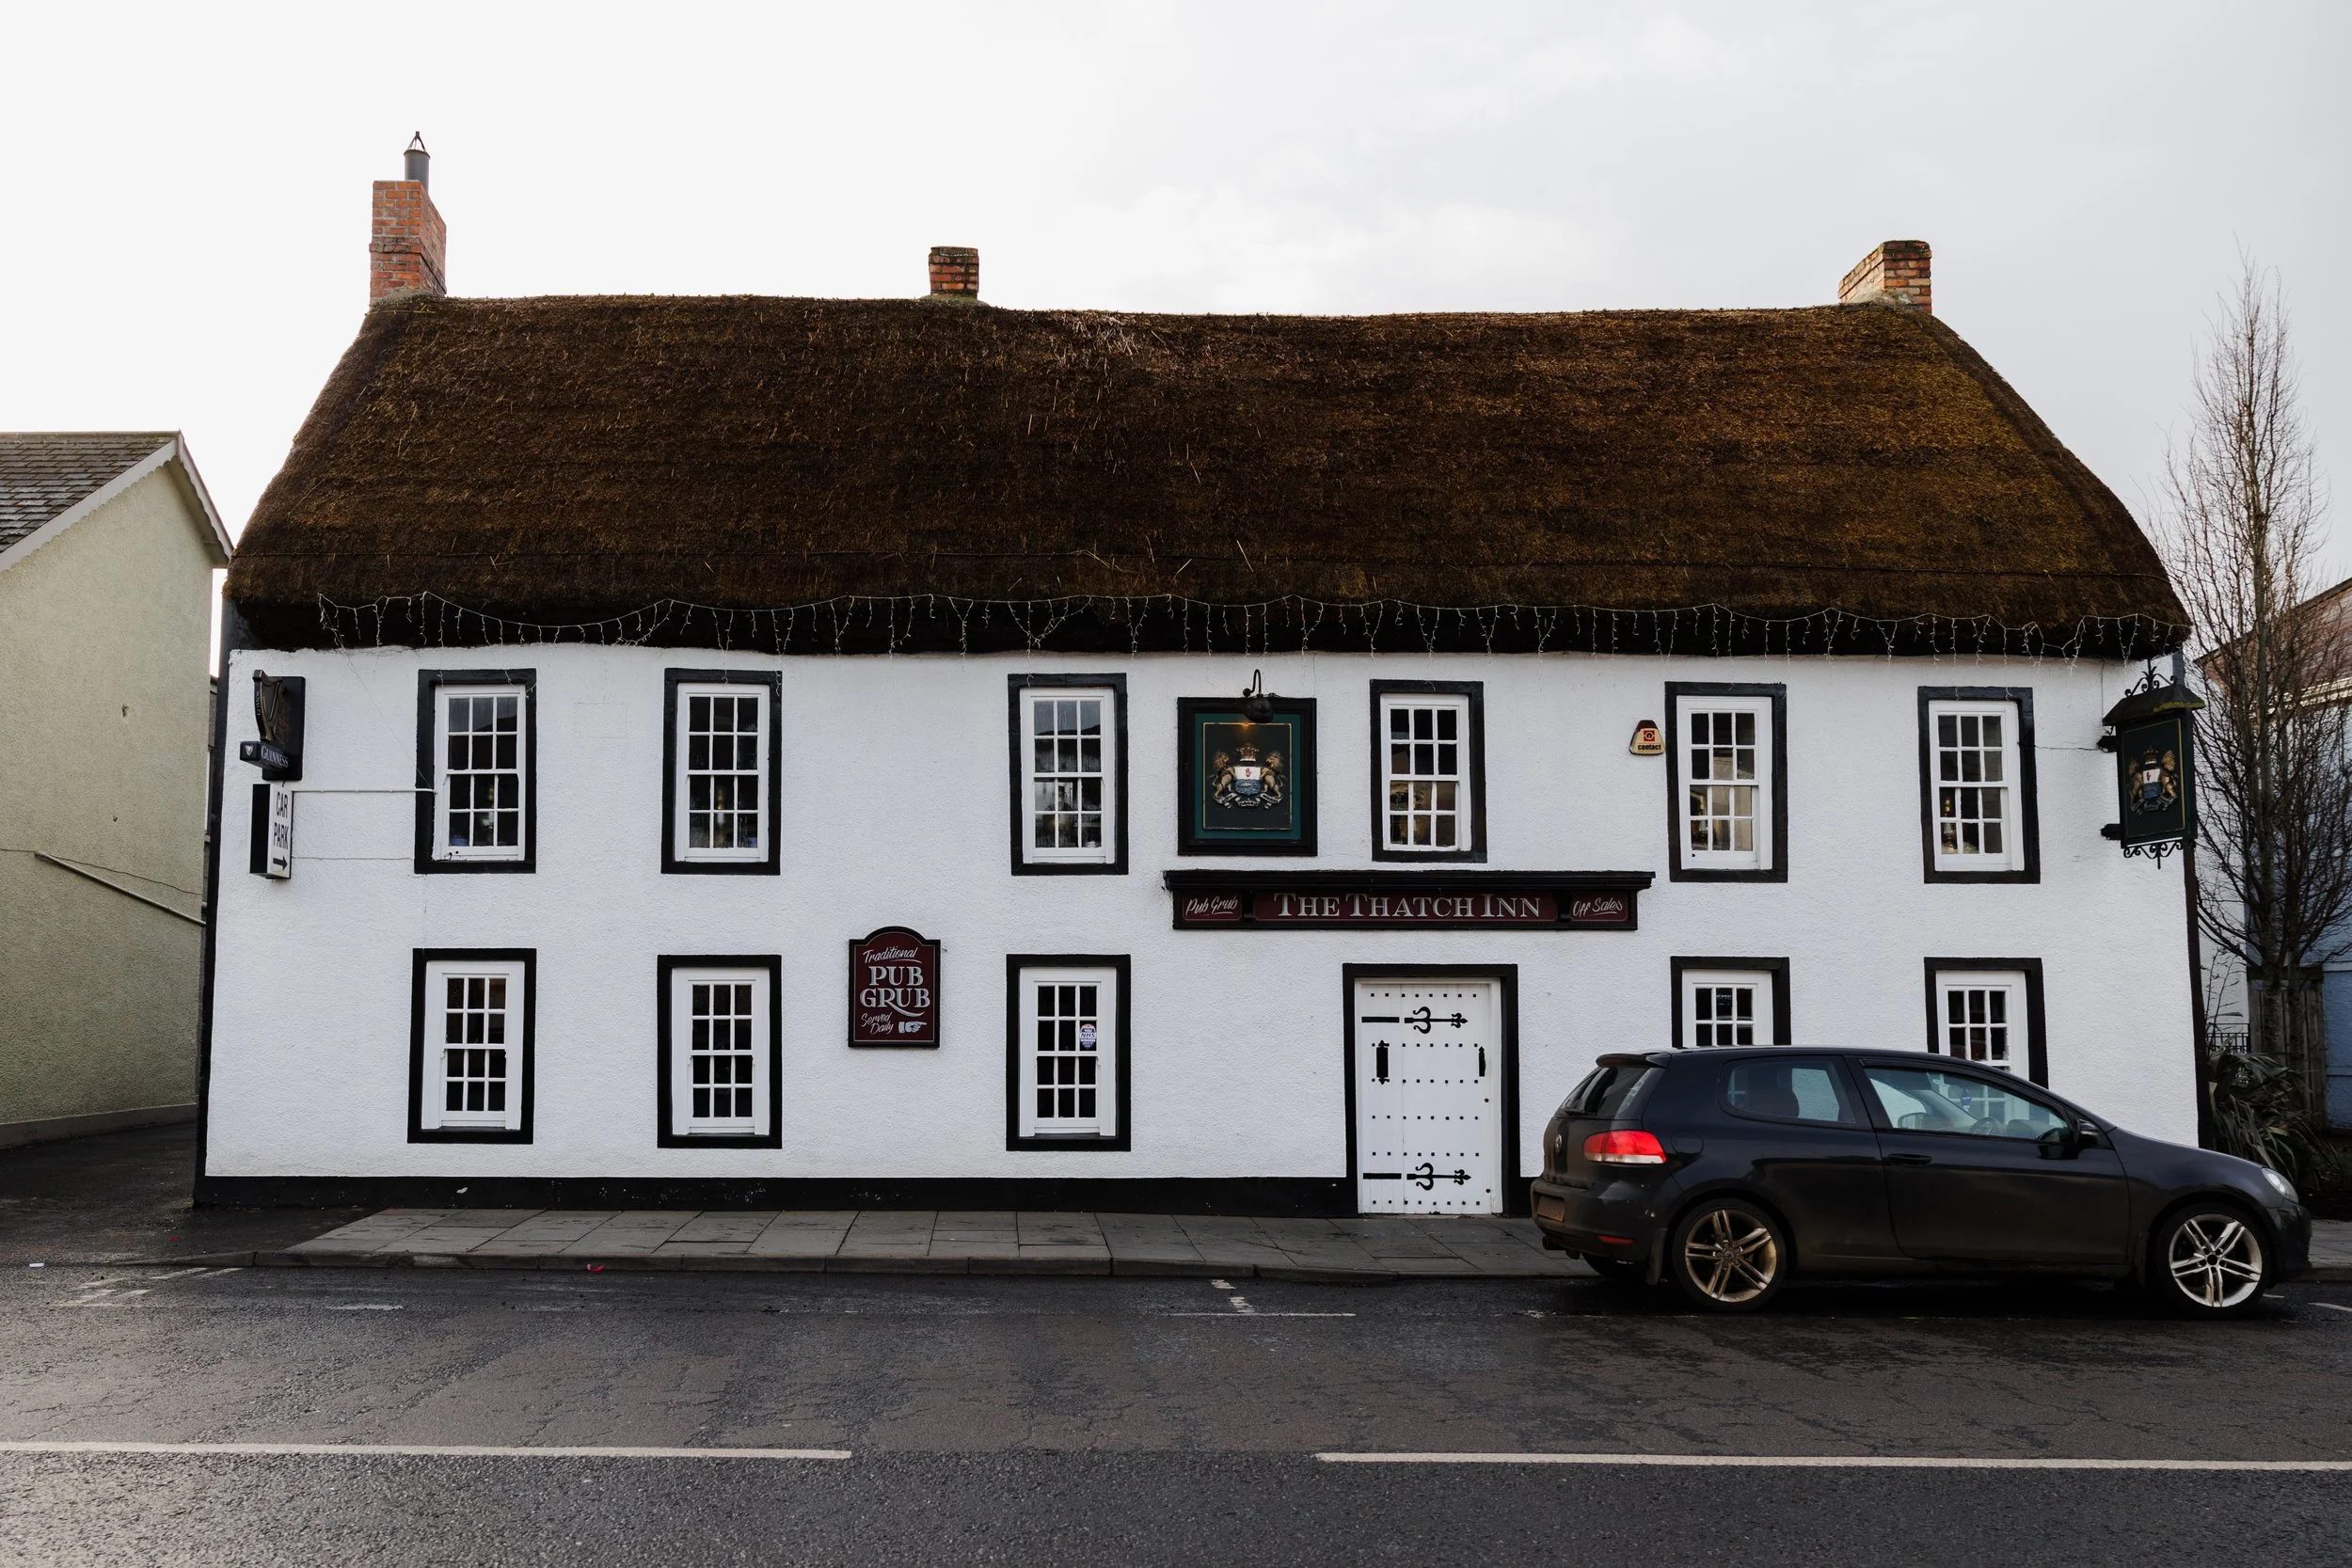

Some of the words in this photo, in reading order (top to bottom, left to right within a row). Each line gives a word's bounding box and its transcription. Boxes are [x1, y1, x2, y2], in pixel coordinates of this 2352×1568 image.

[262, 745, 289, 768] GUINNESS
[276, 791, 288, 818] CAR
[274, 821, 289, 849] PARK
[1185, 897, 1209, 916] Pub
[1211, 895, 1238, 914] Grub
[1274, 893, 1340, 917] THE
[1345, 893, 1475, 917] THATCH
[1480, 894, 1541, 918] INN
[1573, 900, 1591, 917] Off
[1592, 896, 1623, 912] Sales
[863, 945, 919, 964] Traditional
[868, 965, 924, 987] PUB
[859, 988, 930, 1017] GRUB
[861, 1011, 892, 1027] Served
[870, 1021, 894, 1035] Daily
